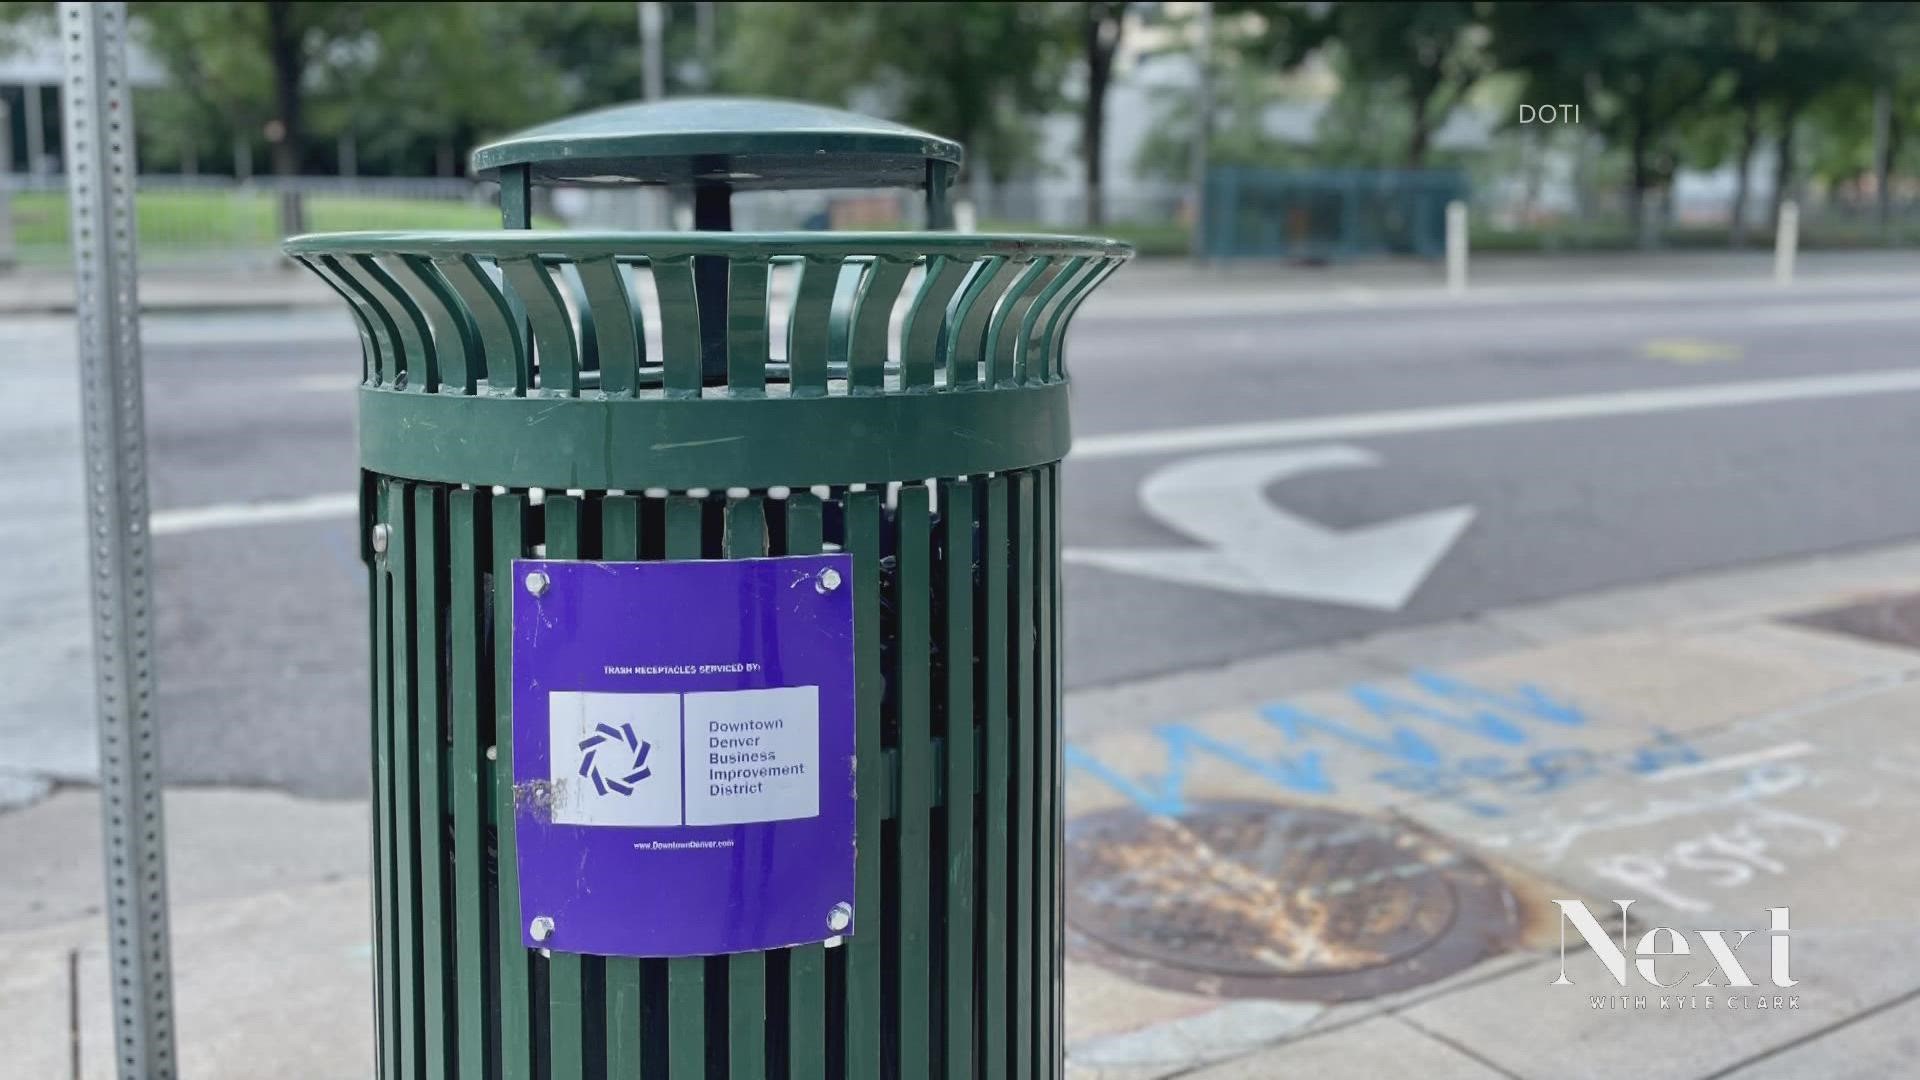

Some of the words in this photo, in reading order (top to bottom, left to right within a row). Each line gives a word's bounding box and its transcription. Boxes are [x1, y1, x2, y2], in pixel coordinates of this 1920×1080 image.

[603, 665, 633, 675] TRASH
[635, 665, 697, 675] RECEPTACLES
[699, 663, 744, 674] SERVICED
[709, 718, 784, 733] Downtown
[709, 736, 761, 749] Denver
[709, 751, 776, 765] Business
[709, 763, 805, 782] Improvement
[710, 781, 763, 797] District
[633, 839, 735, 851] www.DowntownDenver.com
